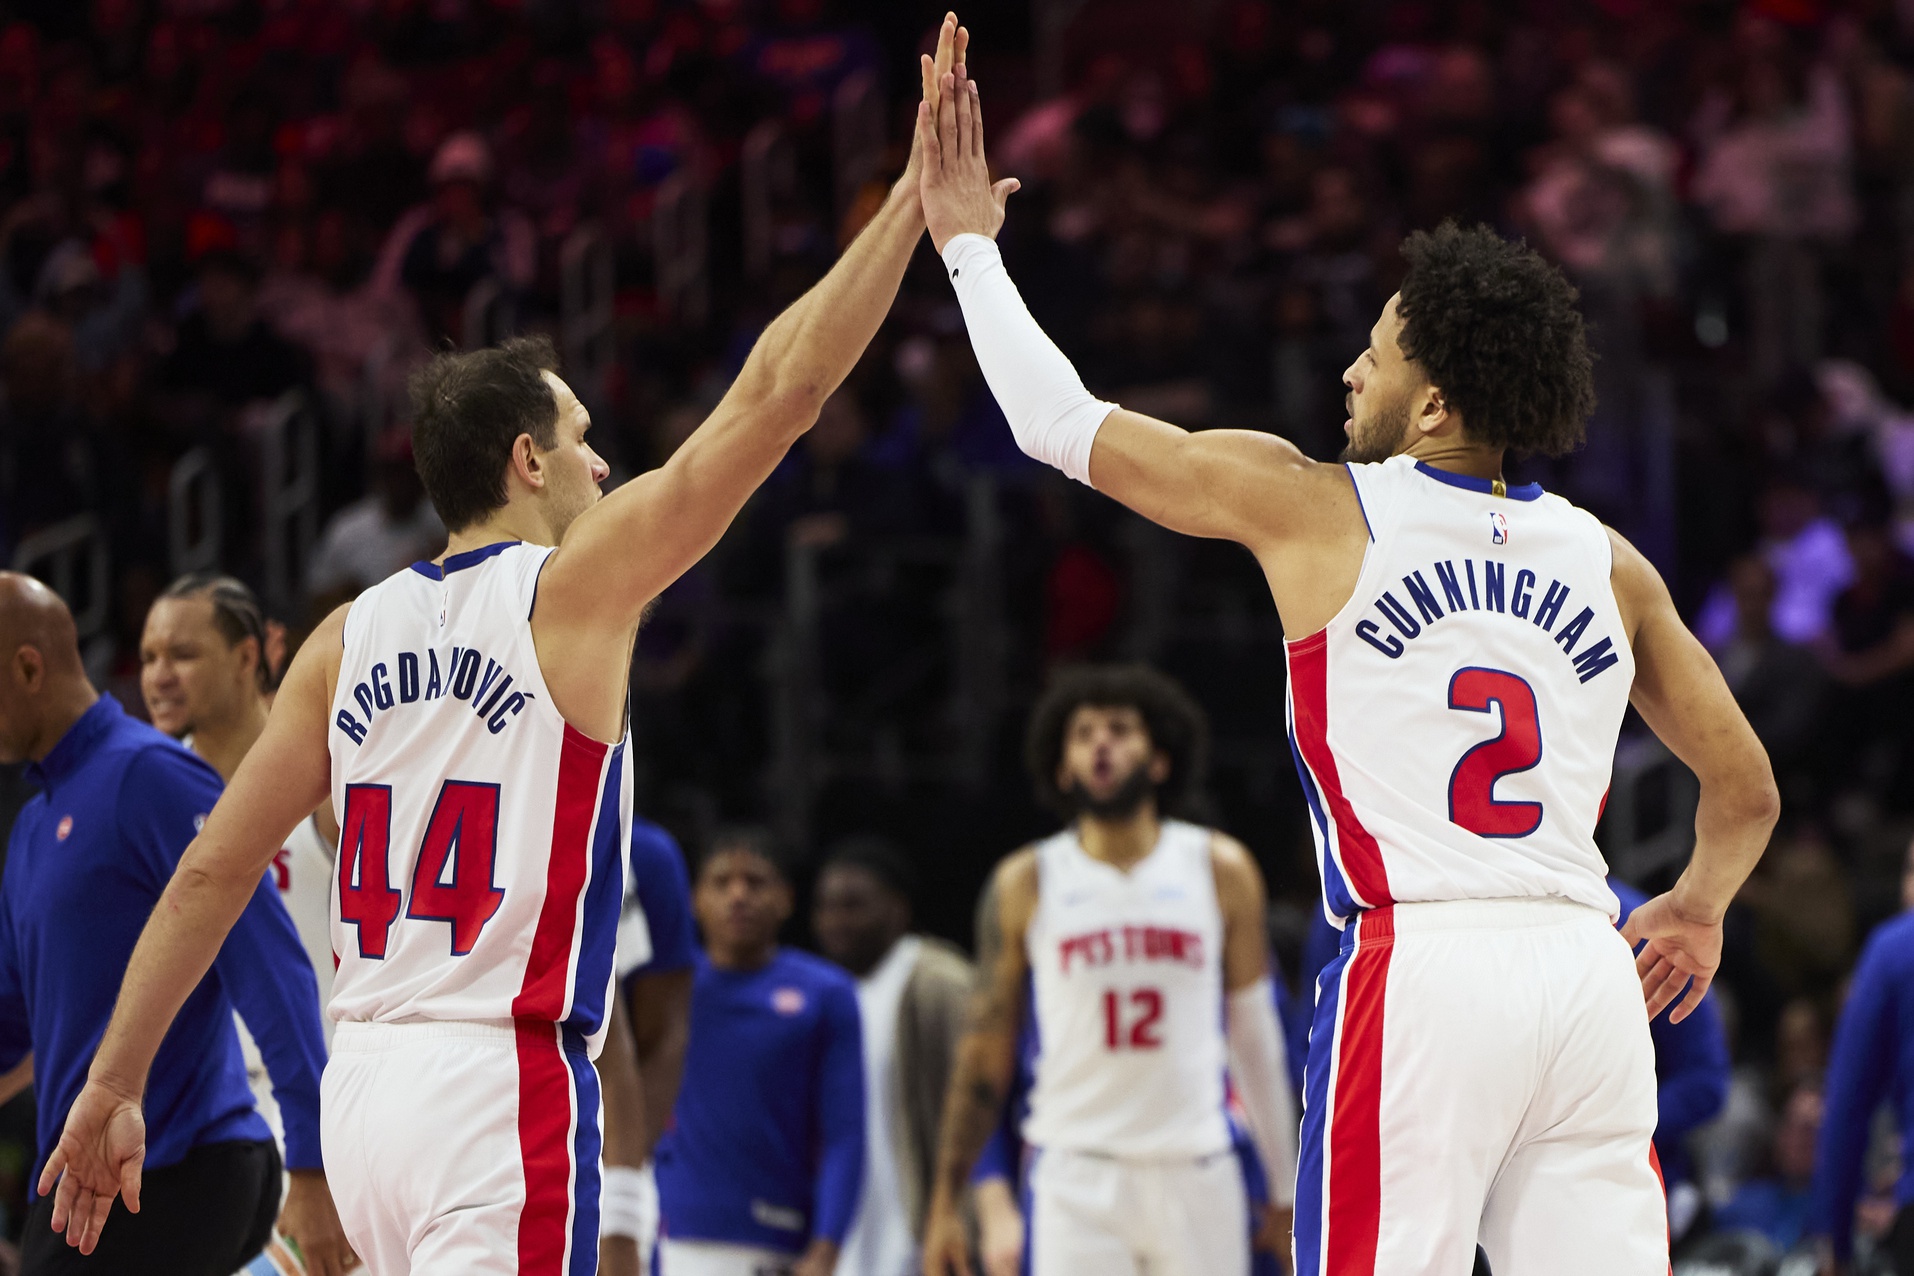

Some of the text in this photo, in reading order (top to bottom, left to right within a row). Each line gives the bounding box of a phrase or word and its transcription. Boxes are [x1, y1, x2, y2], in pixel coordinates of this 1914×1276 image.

[1355, 559, 1619, 685] CUNNINGHAM
[1447, 665, 1543, 839] 2
[338, 778, 506, 961] 44
[1104, 988, 1164, 1051] 12
